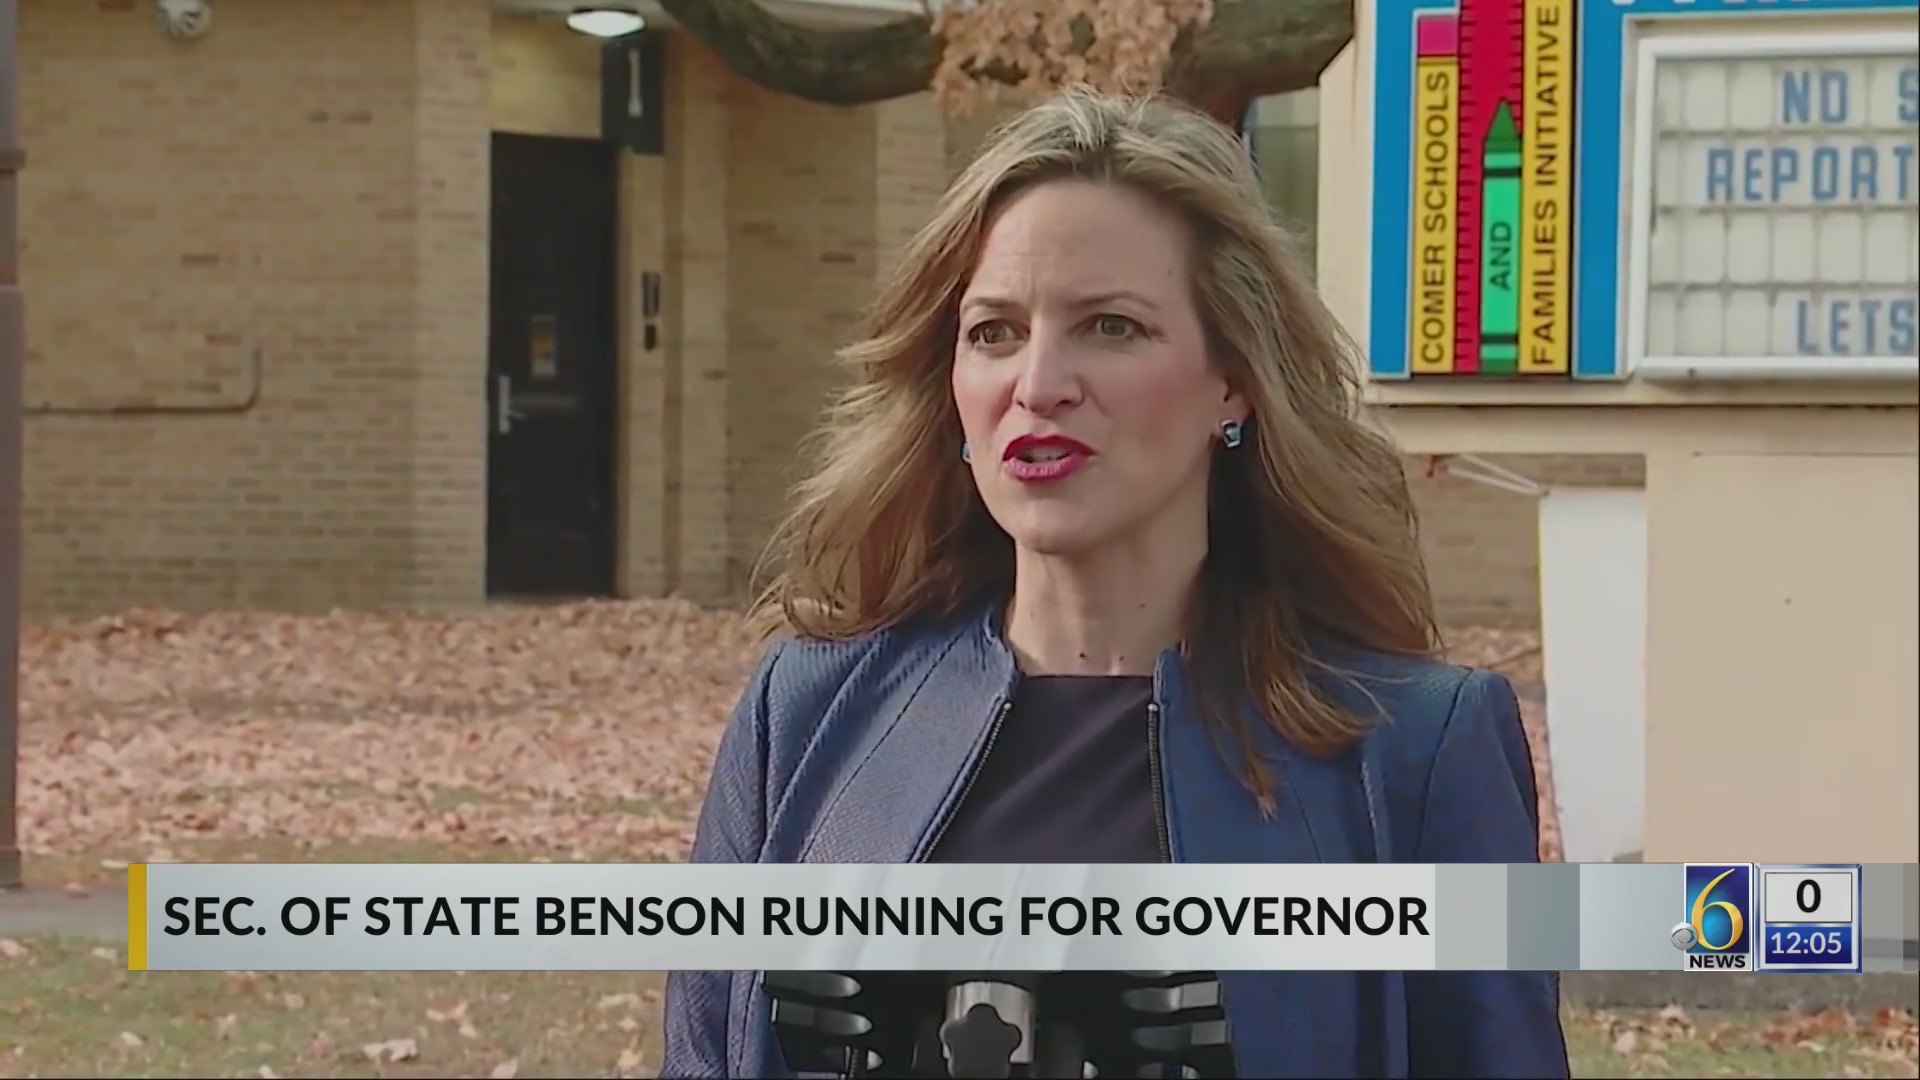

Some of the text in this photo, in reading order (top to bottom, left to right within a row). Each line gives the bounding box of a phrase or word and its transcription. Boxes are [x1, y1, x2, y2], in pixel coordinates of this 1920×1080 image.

[1782, 70, 1848, 123] NO
[1531, 5, 1560, 366] FAMILIES INITIATIVE
[1707, 146, 1913, 202] REPORT
[1420, 71, 1450, 364] COMER SCHOOLS
[1489, 220, 1513, 292] AND
[1797, 300, 1915, 354] LETS
